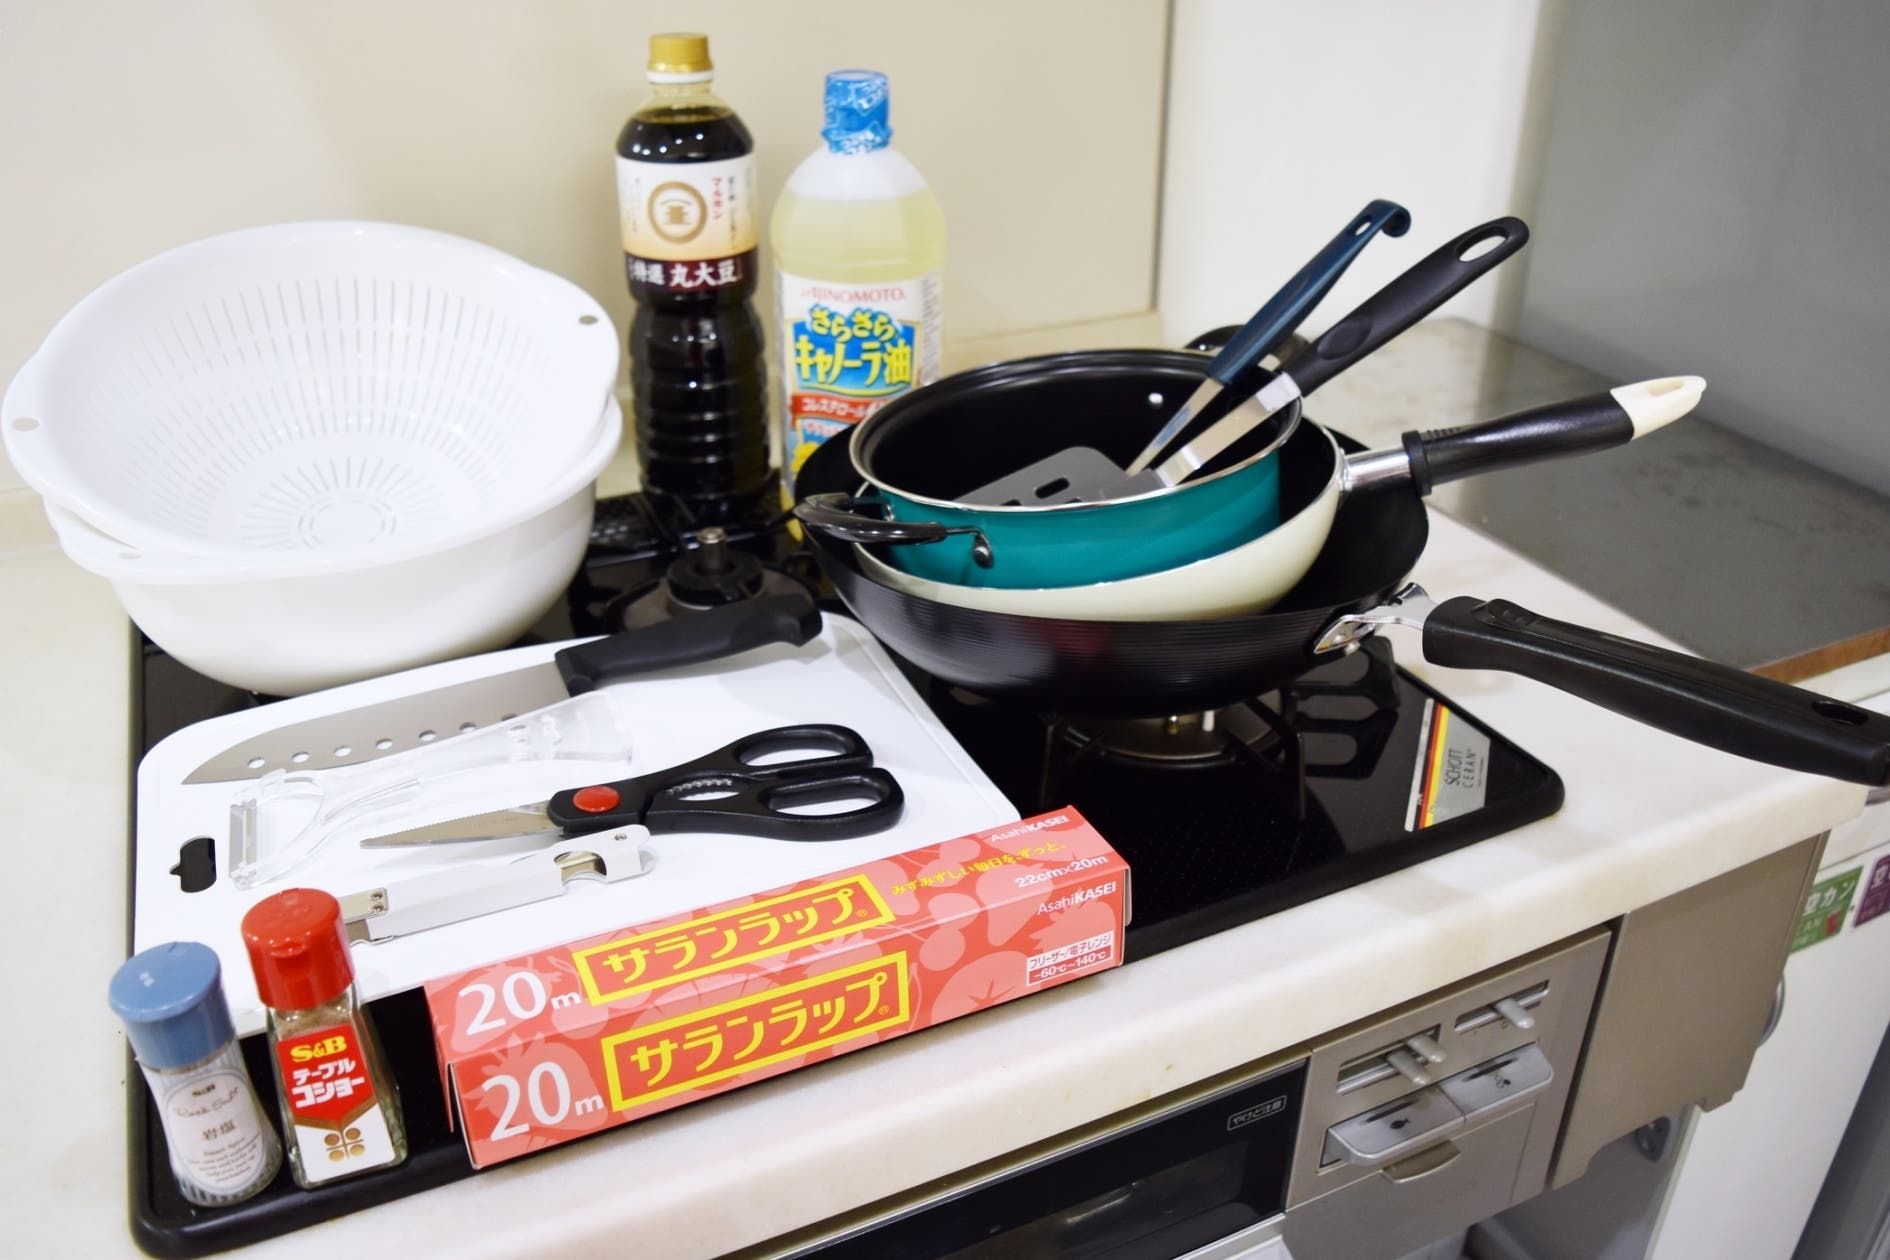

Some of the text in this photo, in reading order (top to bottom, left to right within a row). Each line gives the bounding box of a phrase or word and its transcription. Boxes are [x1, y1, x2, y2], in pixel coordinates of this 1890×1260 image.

[670, 259, 737, 288] 丸大豆
[811, 306, 896, 342] さらさら
[795, 335, 912, 386] キャノーラ油
[1445, 748, 1463, 787] SCHOTT
[1462, 751, 1476, 789] CERAN
[991, 815, 1070, 843] AsahiKASEI
[1036, 881, 1117, 915] AsahiKASEI
[603, 887, 855, 984] サランラップ
[459, 970, 582, 1036] 20m
[630, 971, 888, 1087] サランラップ
[290, 1035, 347, 1062] S&B
[292, 1058, 356, 1085] テーブル
[292, 1076, 365, 1108] コショー
[482, 1061, 604, 1142] 20m
